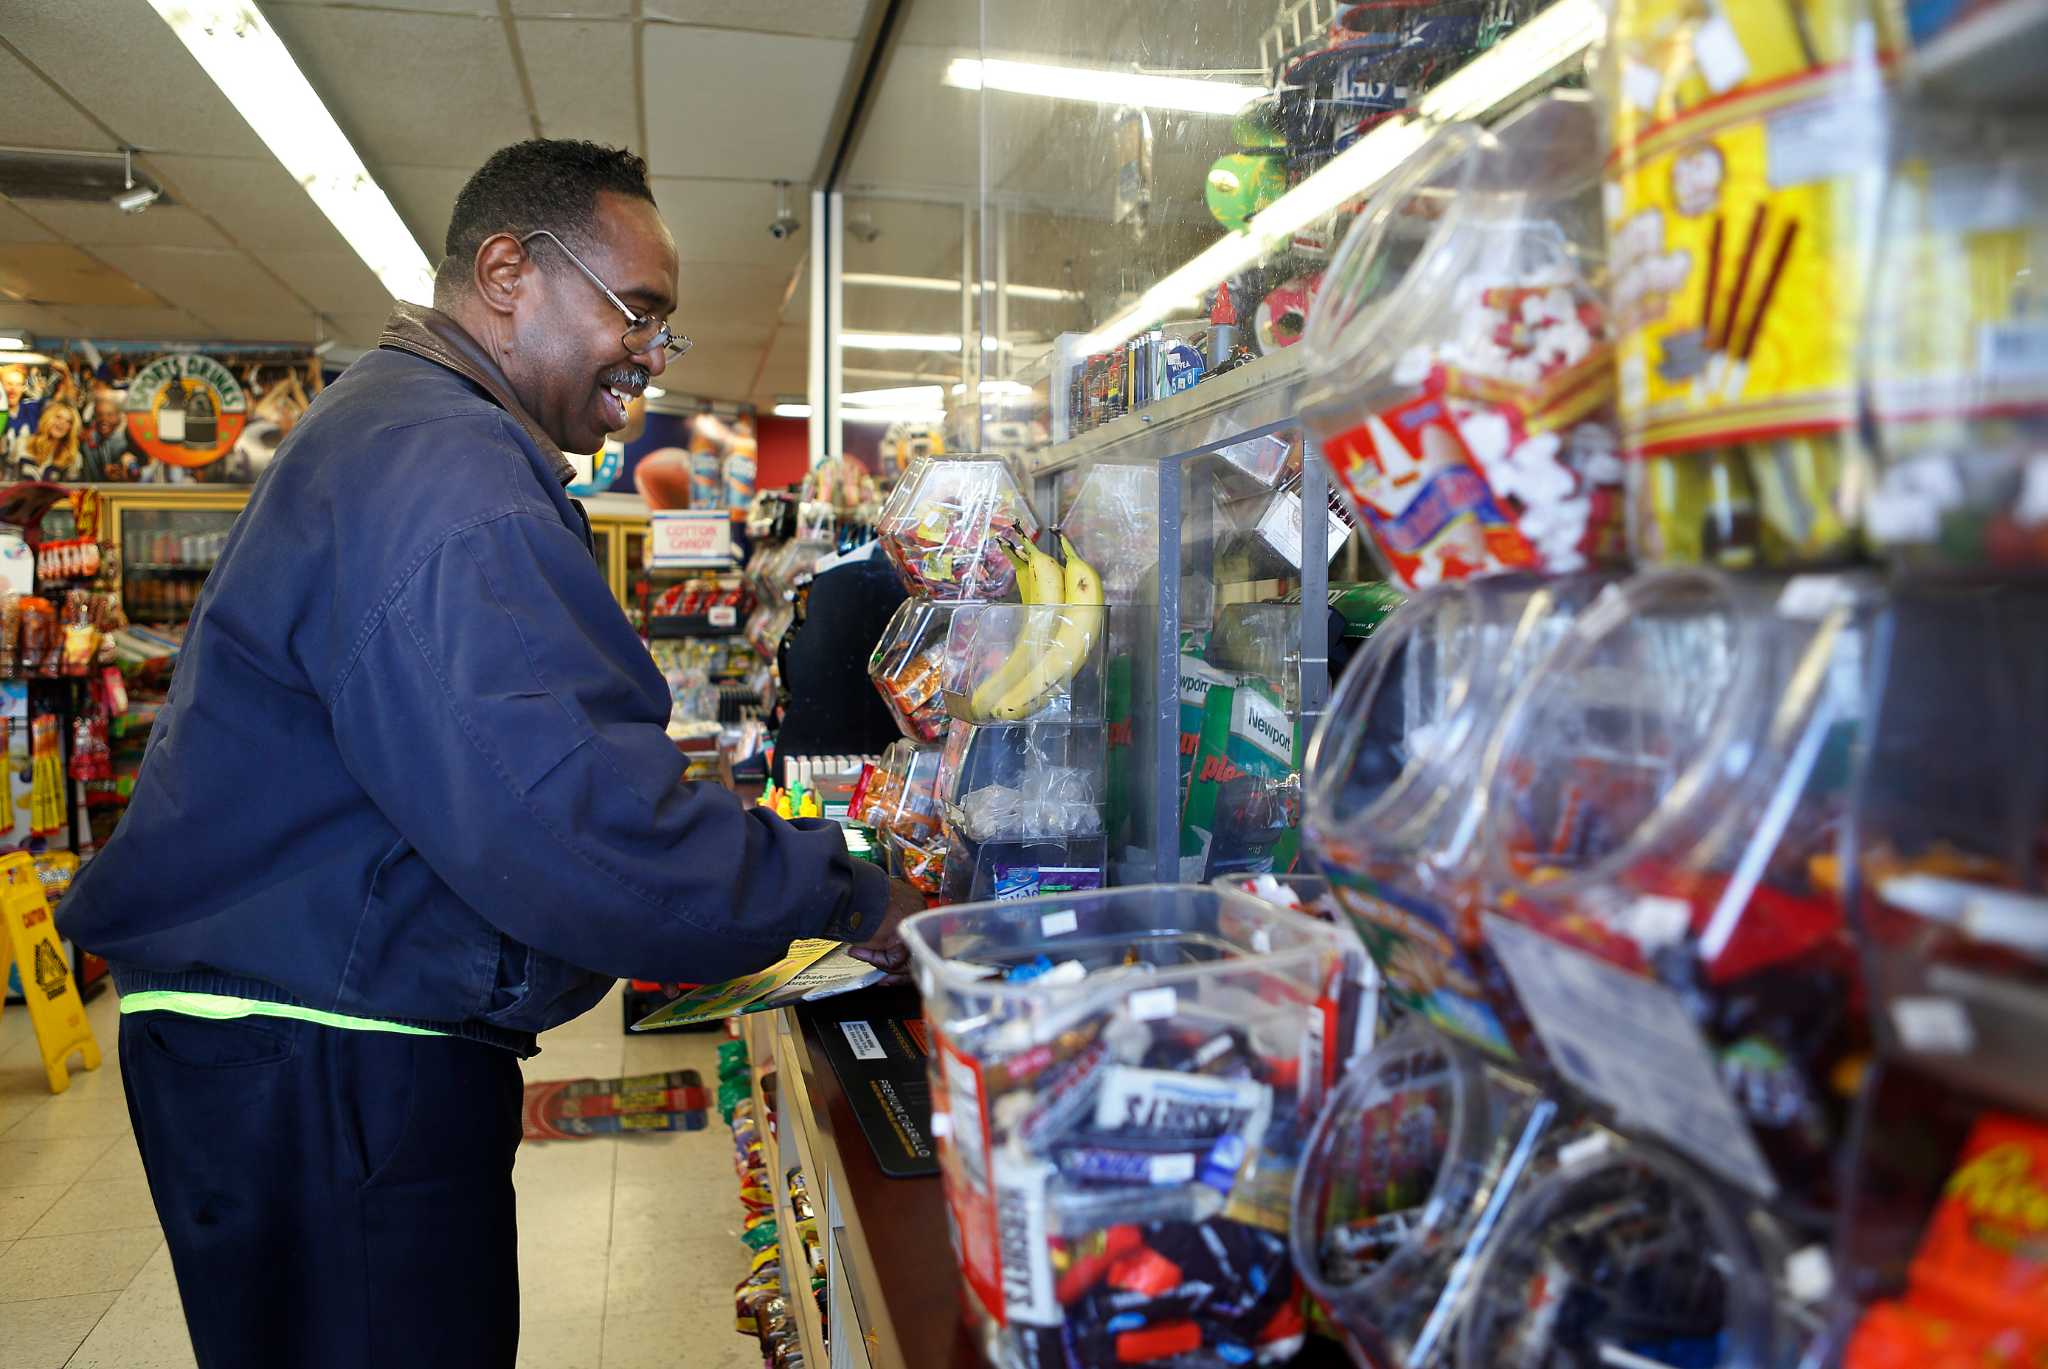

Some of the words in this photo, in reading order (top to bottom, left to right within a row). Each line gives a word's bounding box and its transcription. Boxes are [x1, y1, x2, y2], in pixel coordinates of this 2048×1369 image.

[131, 359, 182, 408] SPORTS
[187, 358, 243, 407] DRINKS
[1172, 360, 1192, 372] NIVEA
[666, 526, 716, 538] COTTON
[1247, 706, 1292, 752] Newport
[896, 1112, 932, 1158] CIGARILLO
